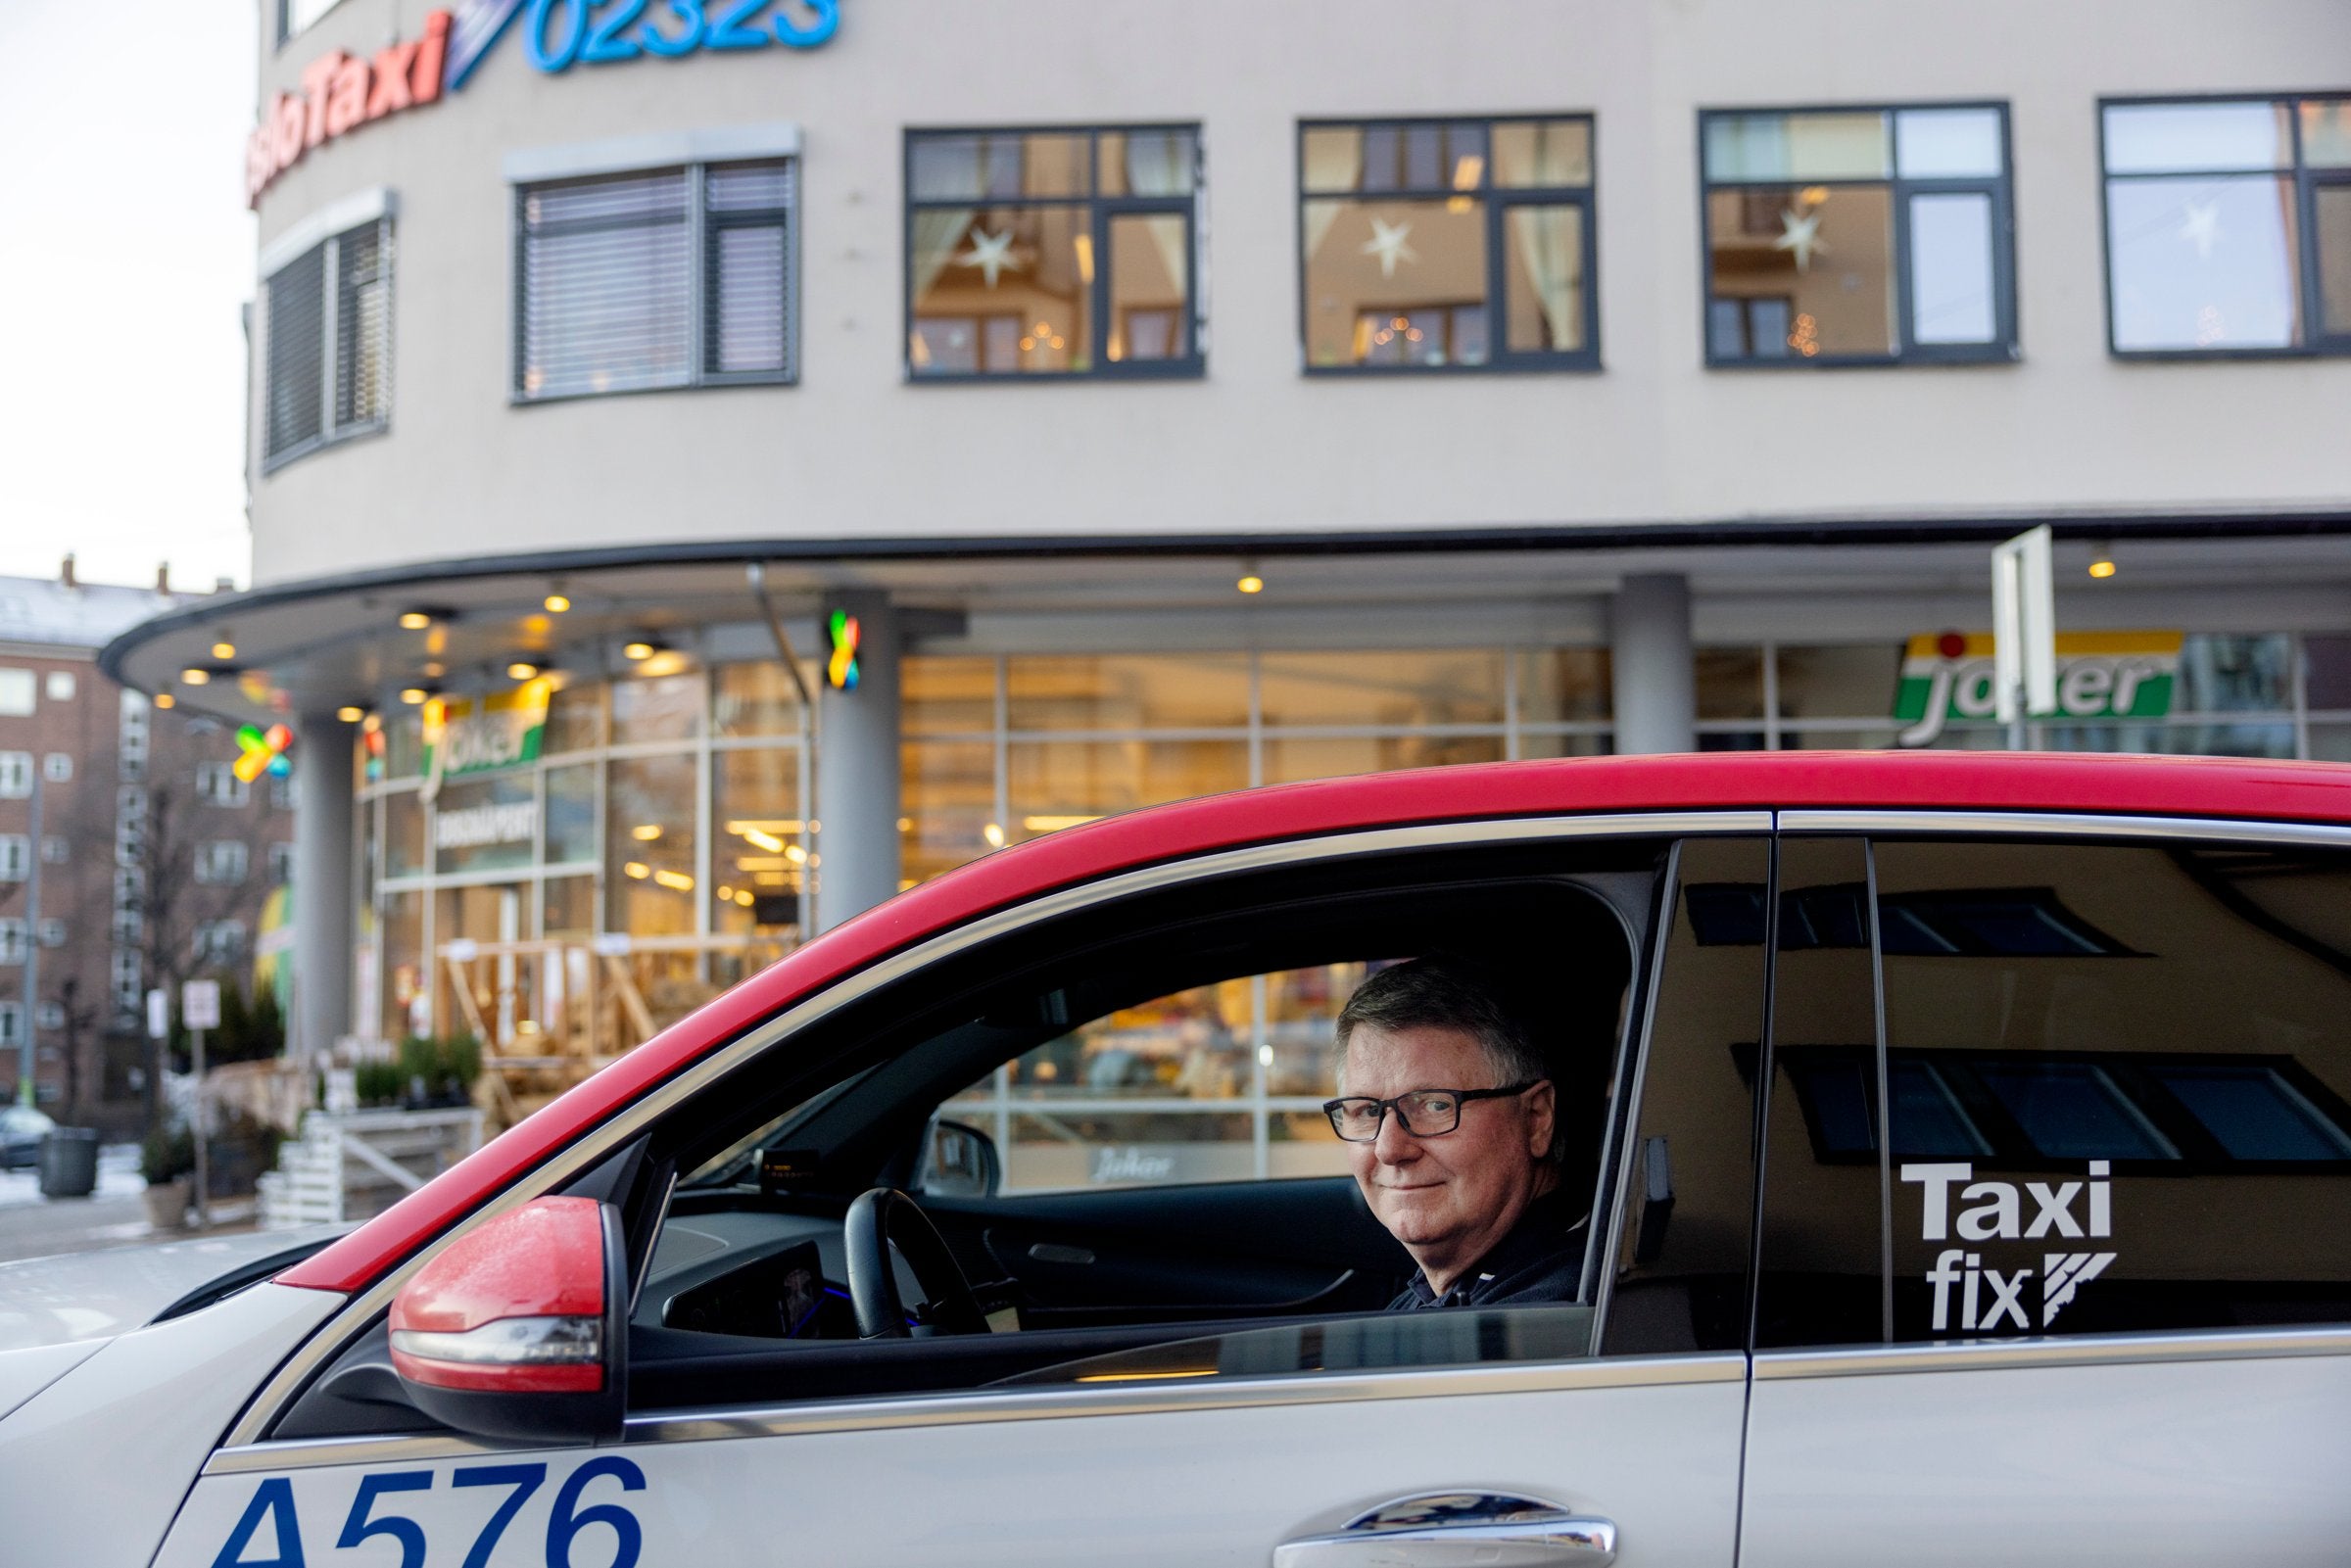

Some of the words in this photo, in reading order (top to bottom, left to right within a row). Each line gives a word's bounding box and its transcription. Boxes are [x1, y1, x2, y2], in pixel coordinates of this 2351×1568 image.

[523, 0, 840, 72] 02323
[1898, 632, 2159, 748] joer
[1900, 1160, 2111, 1241] Taxi
[1926, 1249, 2034, 1331] fix
[210, 1455, 648, 1568] A576
